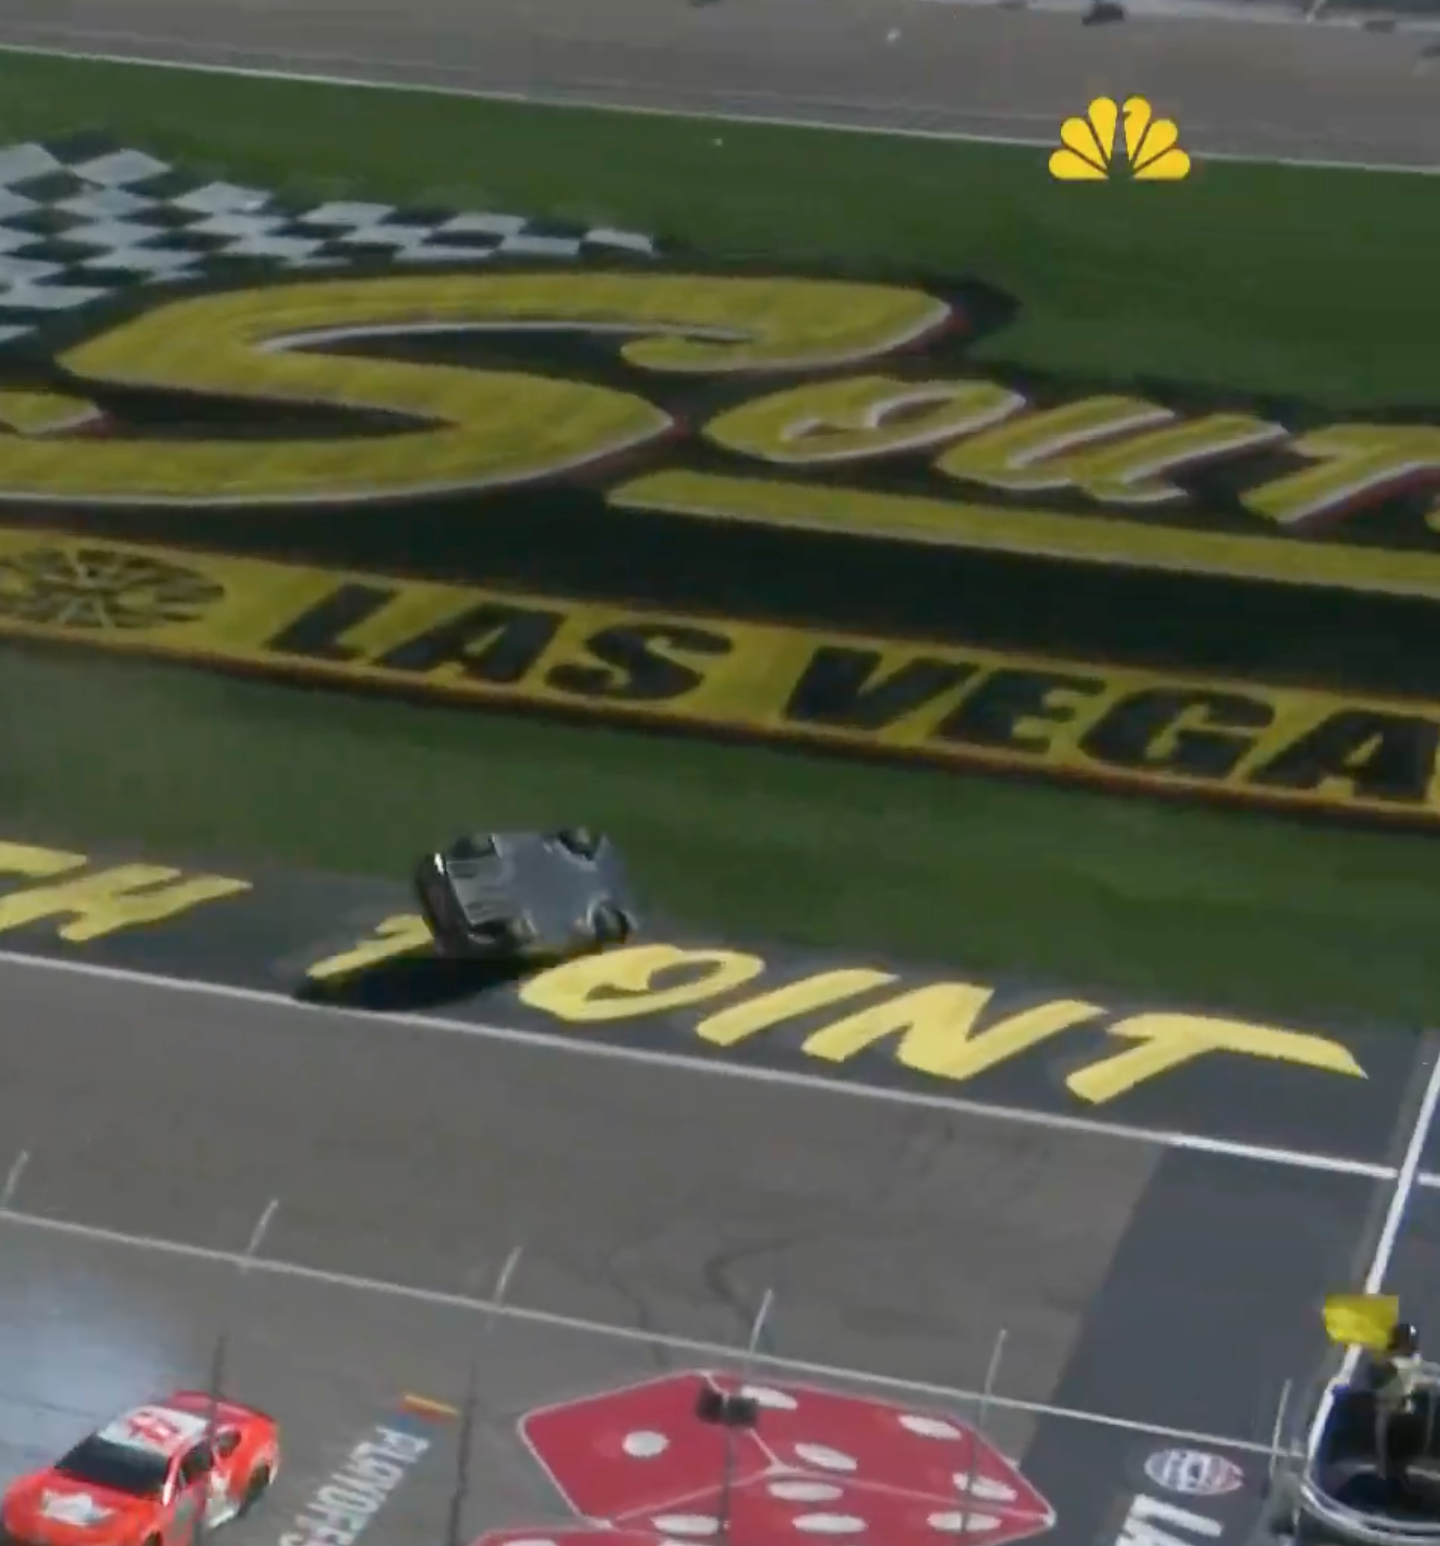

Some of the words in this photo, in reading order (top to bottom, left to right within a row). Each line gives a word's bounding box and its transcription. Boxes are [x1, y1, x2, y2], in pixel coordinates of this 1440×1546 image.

[262, 582, 735, 700] LAS
[782, 644, 1440, 801] VEGA
[276, 1424, 431, 1546] PLAYOFF
